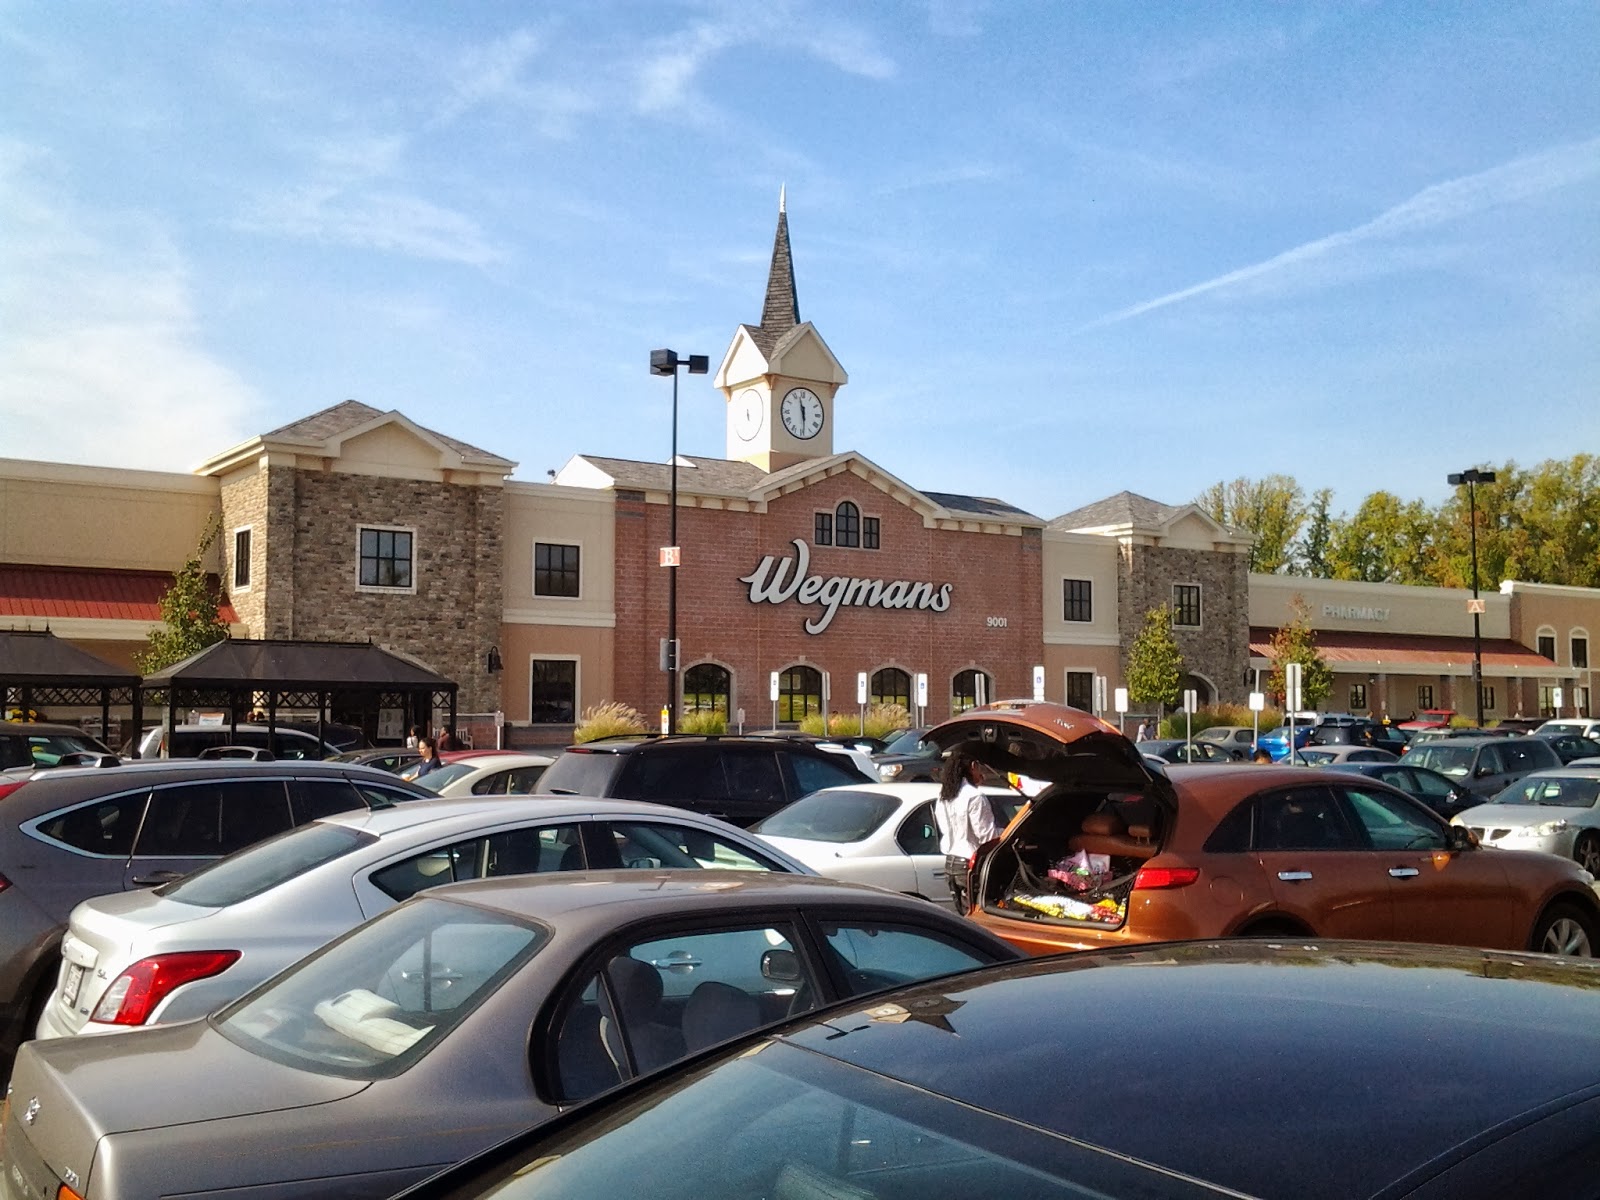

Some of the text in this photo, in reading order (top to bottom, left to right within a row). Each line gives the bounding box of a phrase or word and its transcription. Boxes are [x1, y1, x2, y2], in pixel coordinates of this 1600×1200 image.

[738, 538, 954, 635] Wegmans
[1322, 604, 1391, 621] PHARMACY
[986, 616, 1008, 628] 9001
